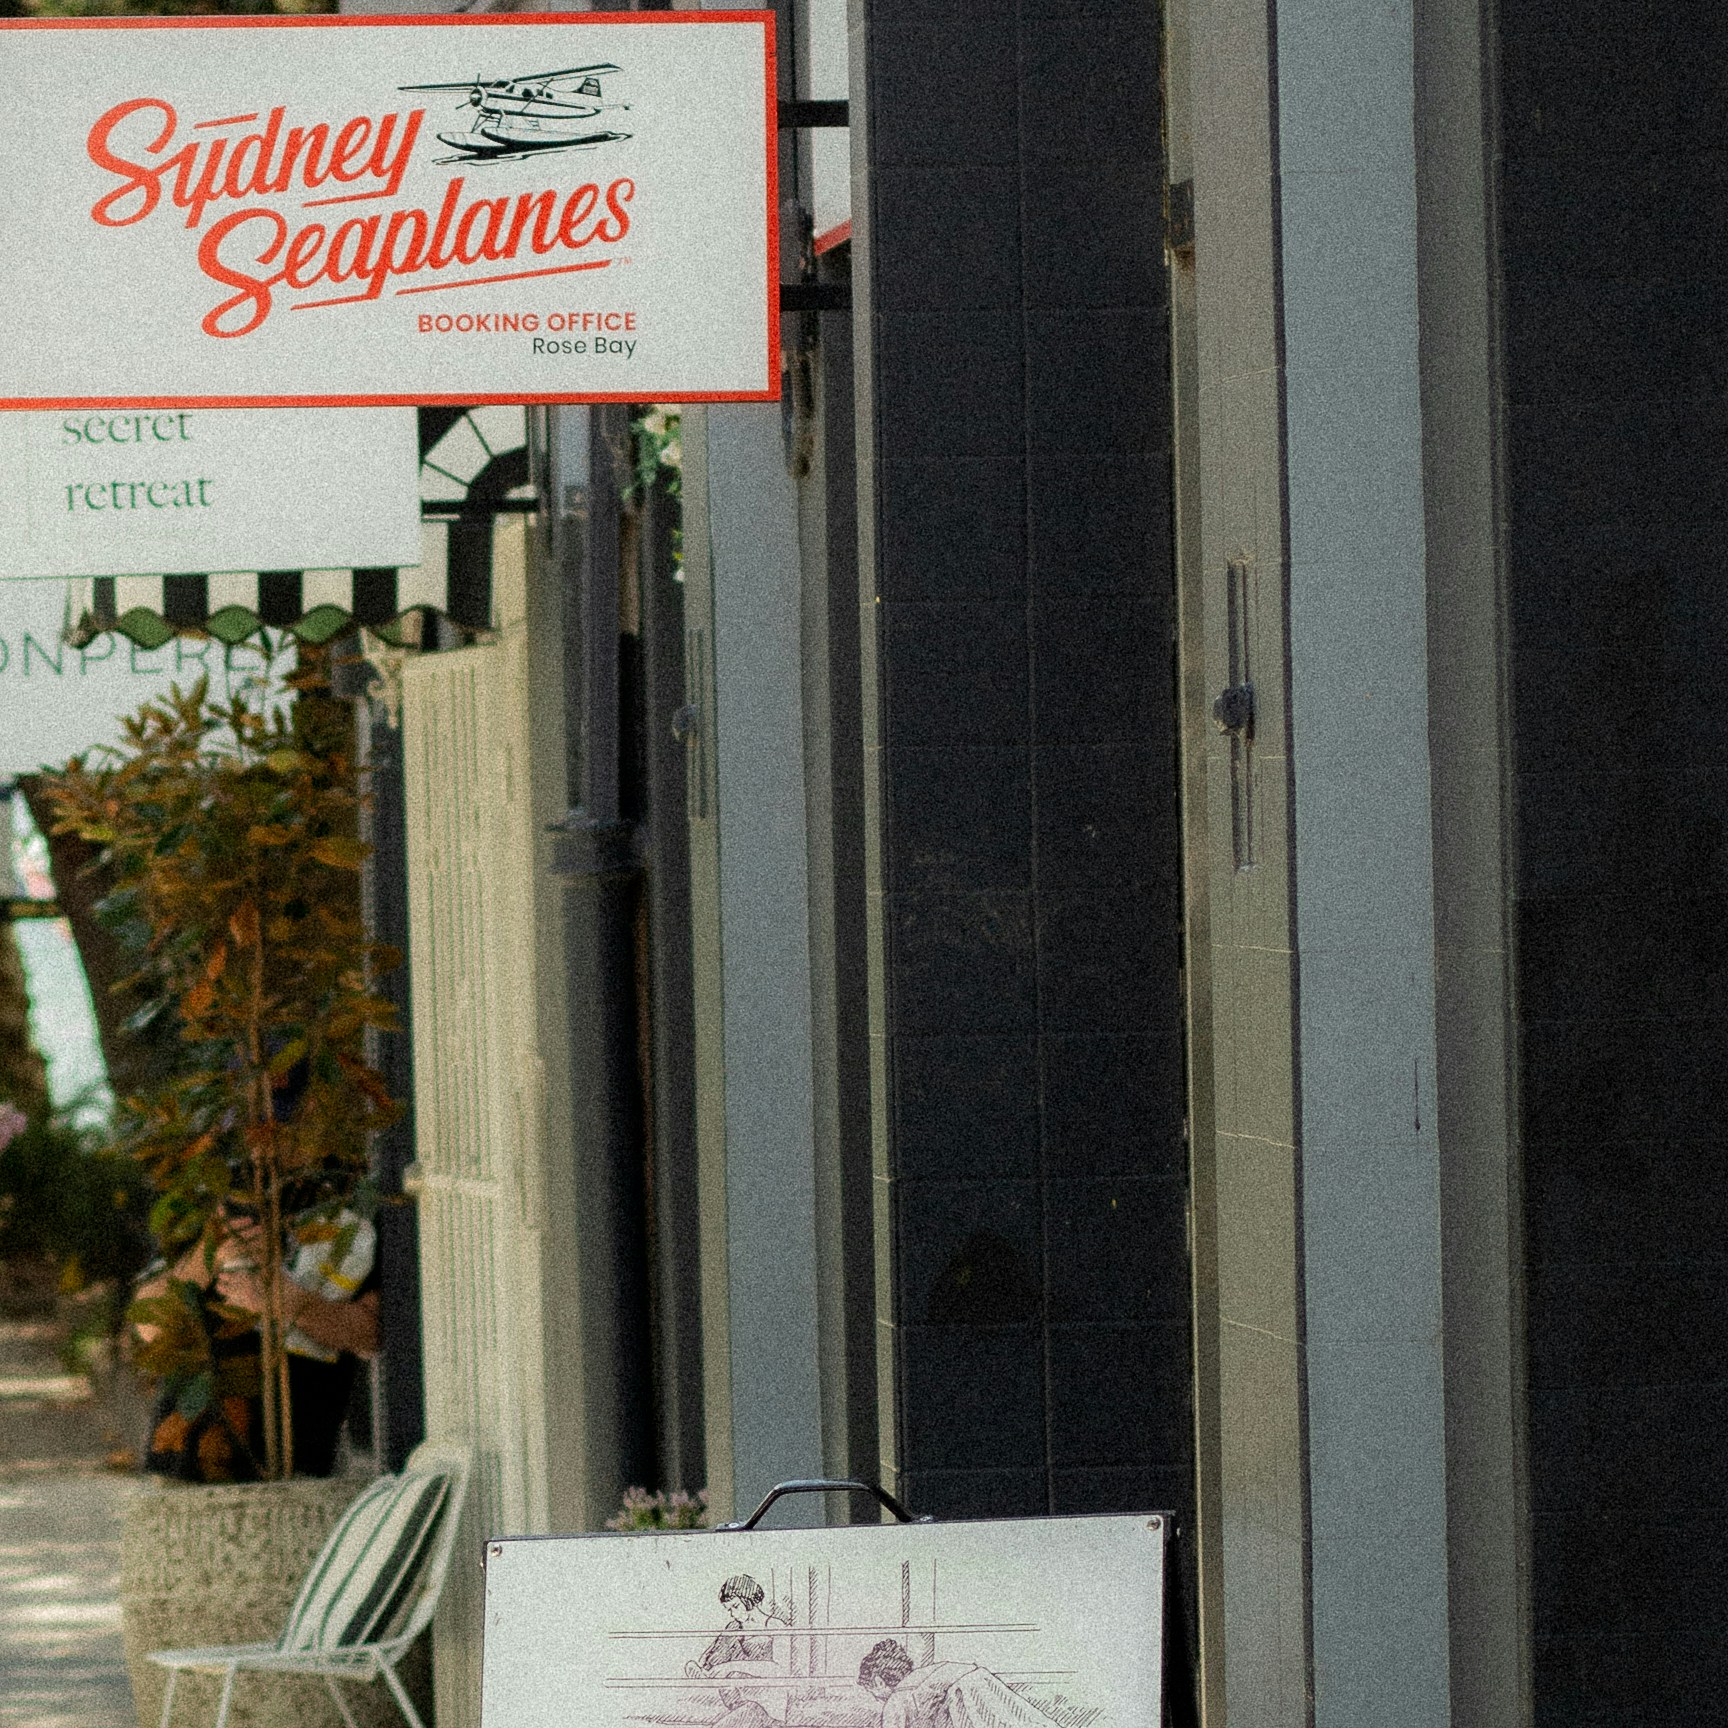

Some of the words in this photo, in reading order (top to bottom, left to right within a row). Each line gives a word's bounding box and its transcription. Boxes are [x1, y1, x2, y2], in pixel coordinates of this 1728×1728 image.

[86, 97, 426, 229] Sydney
[197, 177, 635, 338] Seaplanes
[417, 313, 540, 333] BOOKING
[546, 312, 637, 332] OFFICE
[533, 337, 587, 355] Rose
[595, 336, 637, 359] Bay
[61, 412, 193, 445] secret
[64, 477, 213, 511] retreat
